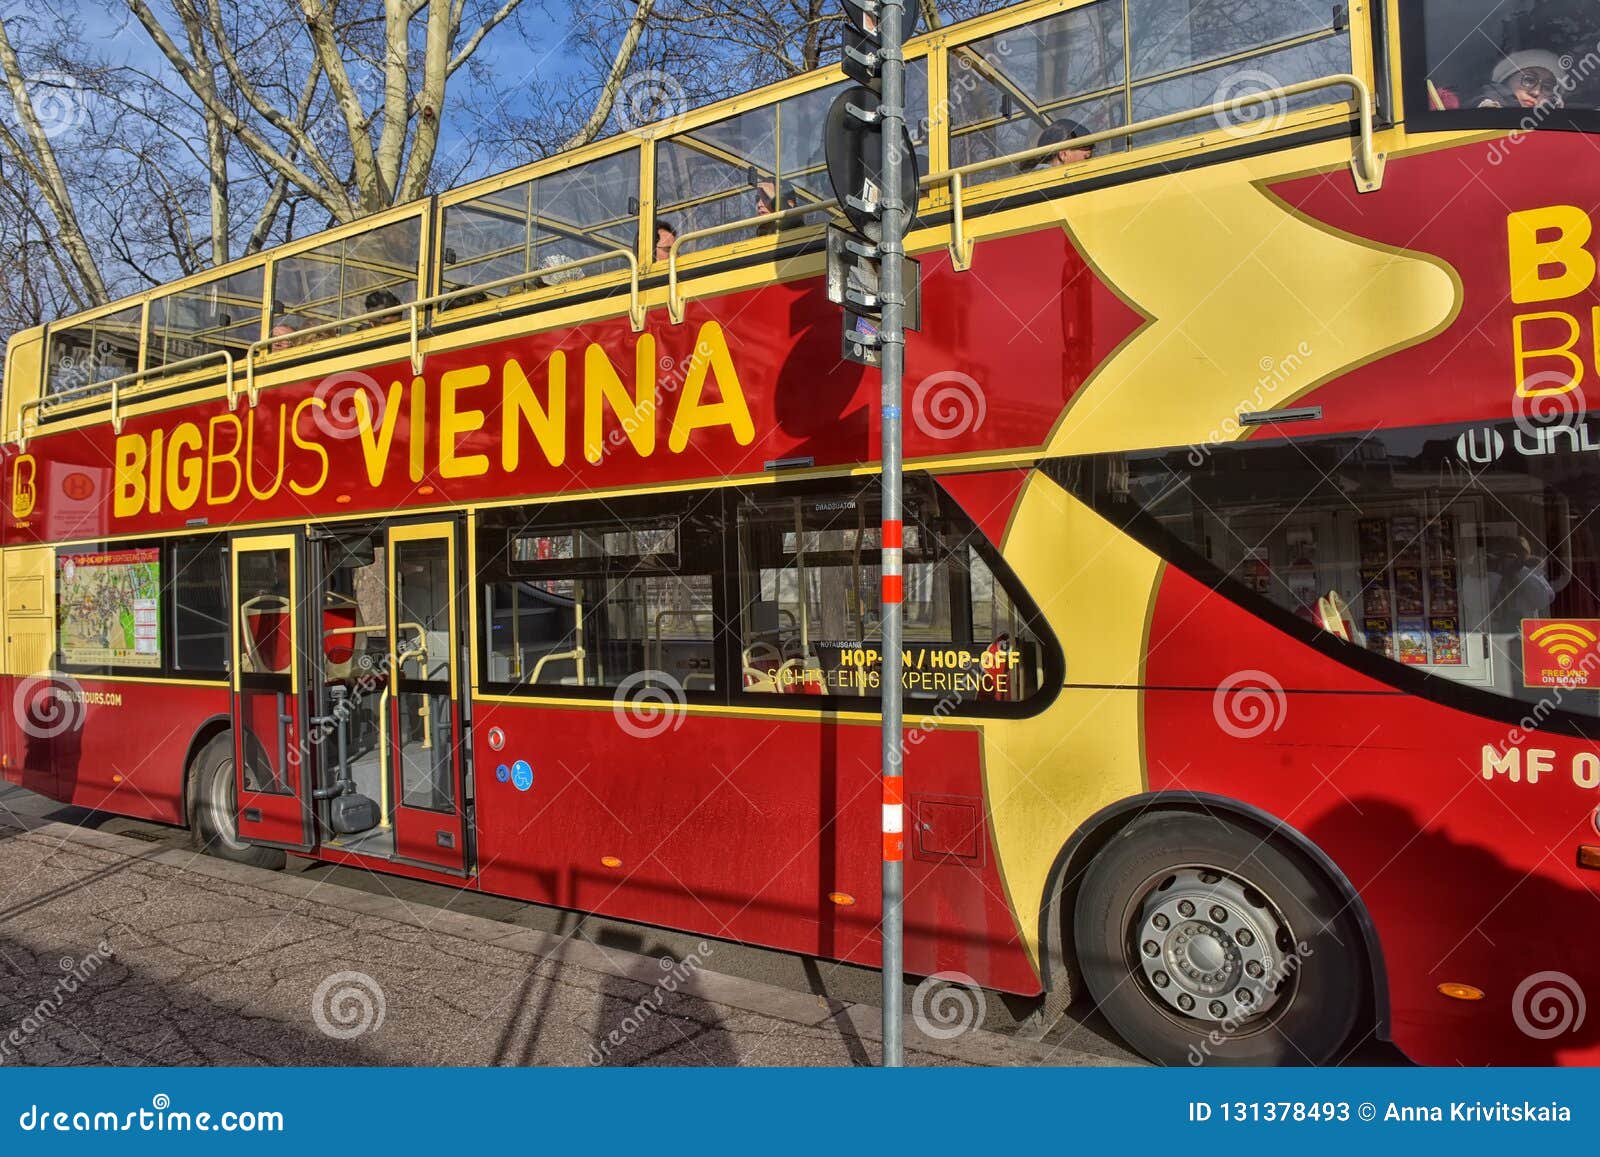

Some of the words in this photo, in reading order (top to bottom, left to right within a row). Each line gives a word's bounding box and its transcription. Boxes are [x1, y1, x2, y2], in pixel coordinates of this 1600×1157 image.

[114, 397, 330, 518] BIGBUS
[354, 320, 756, 488] VIENNA
[841, 649, 912, 669] HOP-N
[931, 651, 1020, 669] HOP-OFF
[768, 667, 880, 690] SIGHTSEEING
[902, 672, 1008, 692] XPERIENCE
[1556, 676, 1588, 684] BOARD
[1482, 745, 1556, 784] MF
